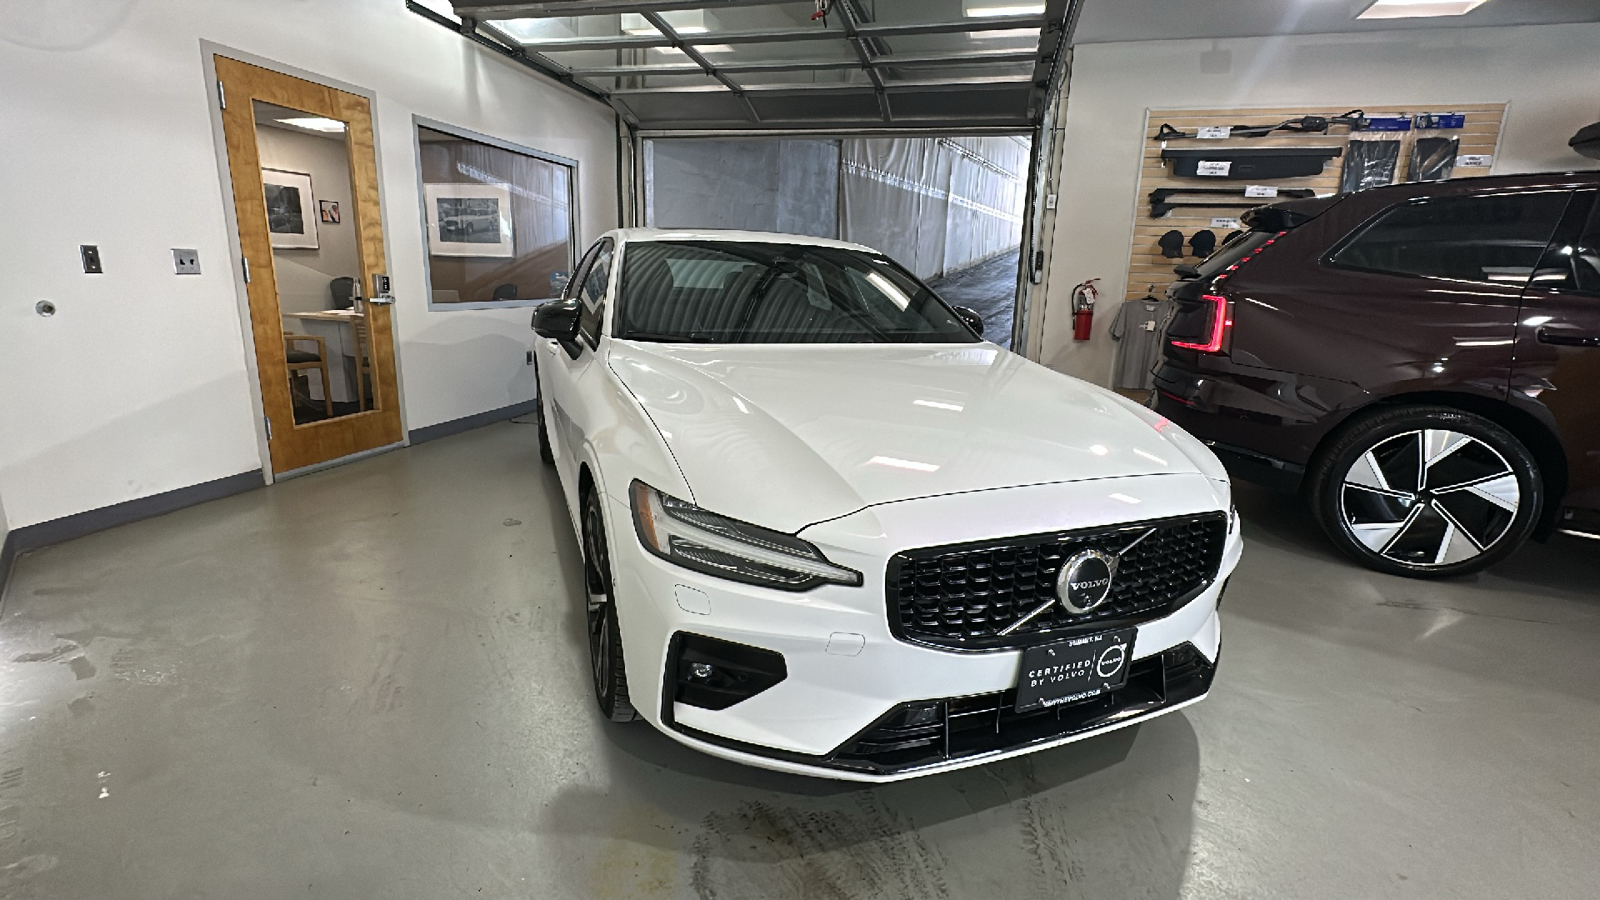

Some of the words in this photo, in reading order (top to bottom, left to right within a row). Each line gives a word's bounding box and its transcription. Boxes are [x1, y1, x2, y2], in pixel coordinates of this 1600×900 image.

[1070, 578, 1109, 590] VOLVO
[1028, 660, 1091, 678] CERTIFIED
[1101, 657, 1121, 666] VOLVO
[1030, 679, 1044, 688] BY
[1050, 669, 1085, 683] VOLVO
